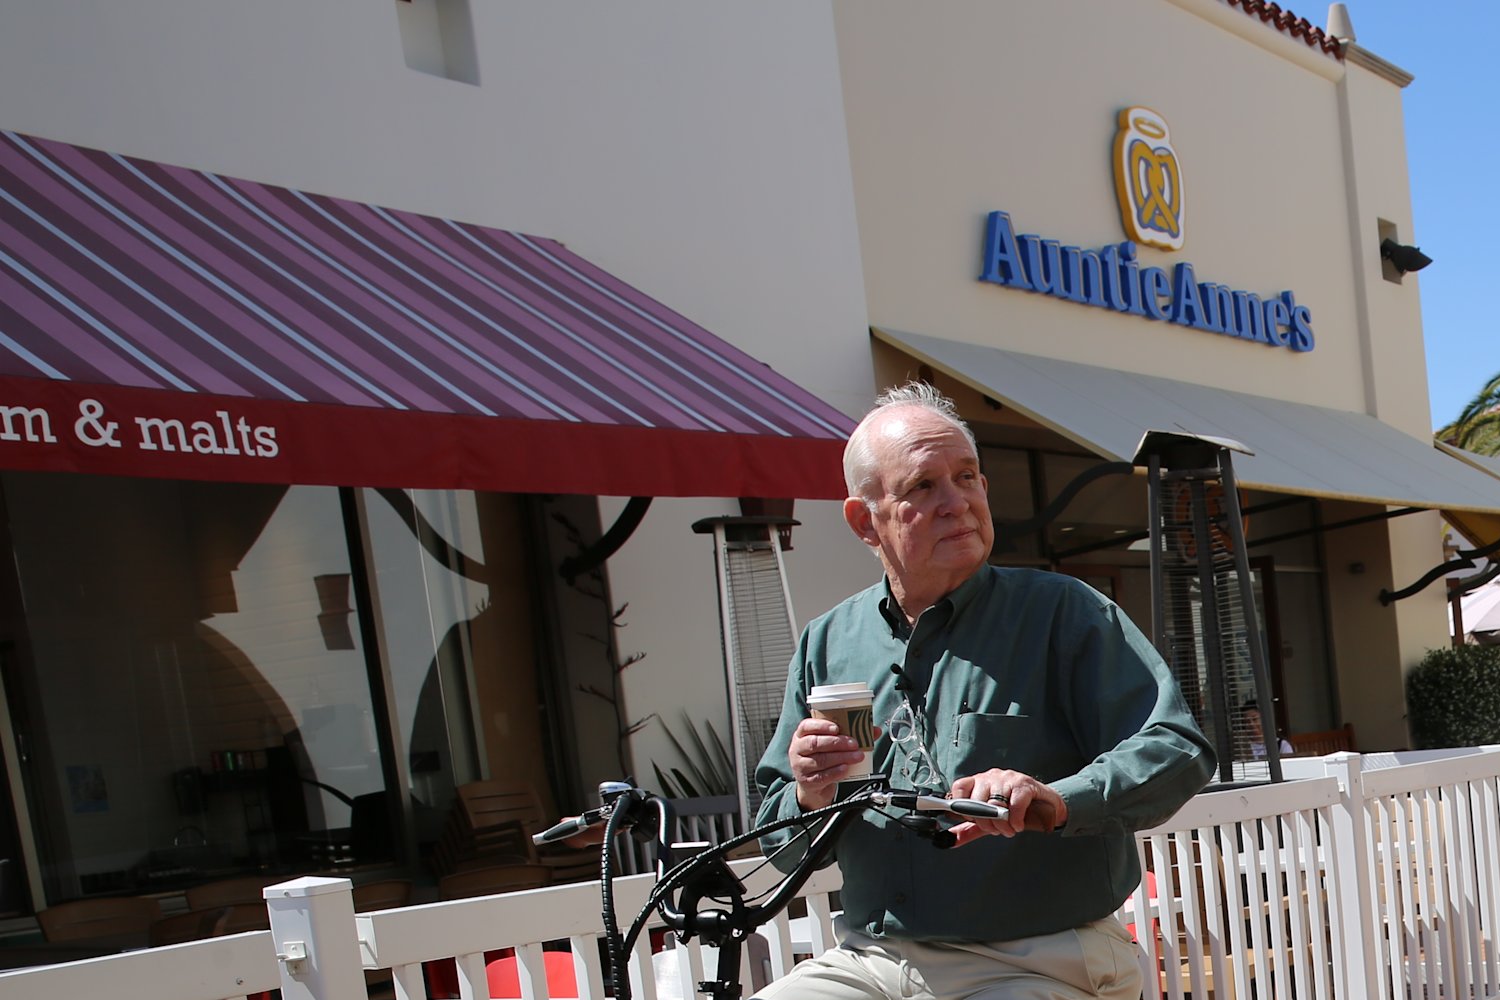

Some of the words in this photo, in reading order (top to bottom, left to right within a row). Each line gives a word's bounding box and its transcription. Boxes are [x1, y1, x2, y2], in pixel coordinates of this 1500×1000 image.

[978, 210, 1173, 322] Auntie
[1169, 262, 1316, 353] Anne's
[74, 398, 122, 448] &
[135, 410, 280, 458] malts
